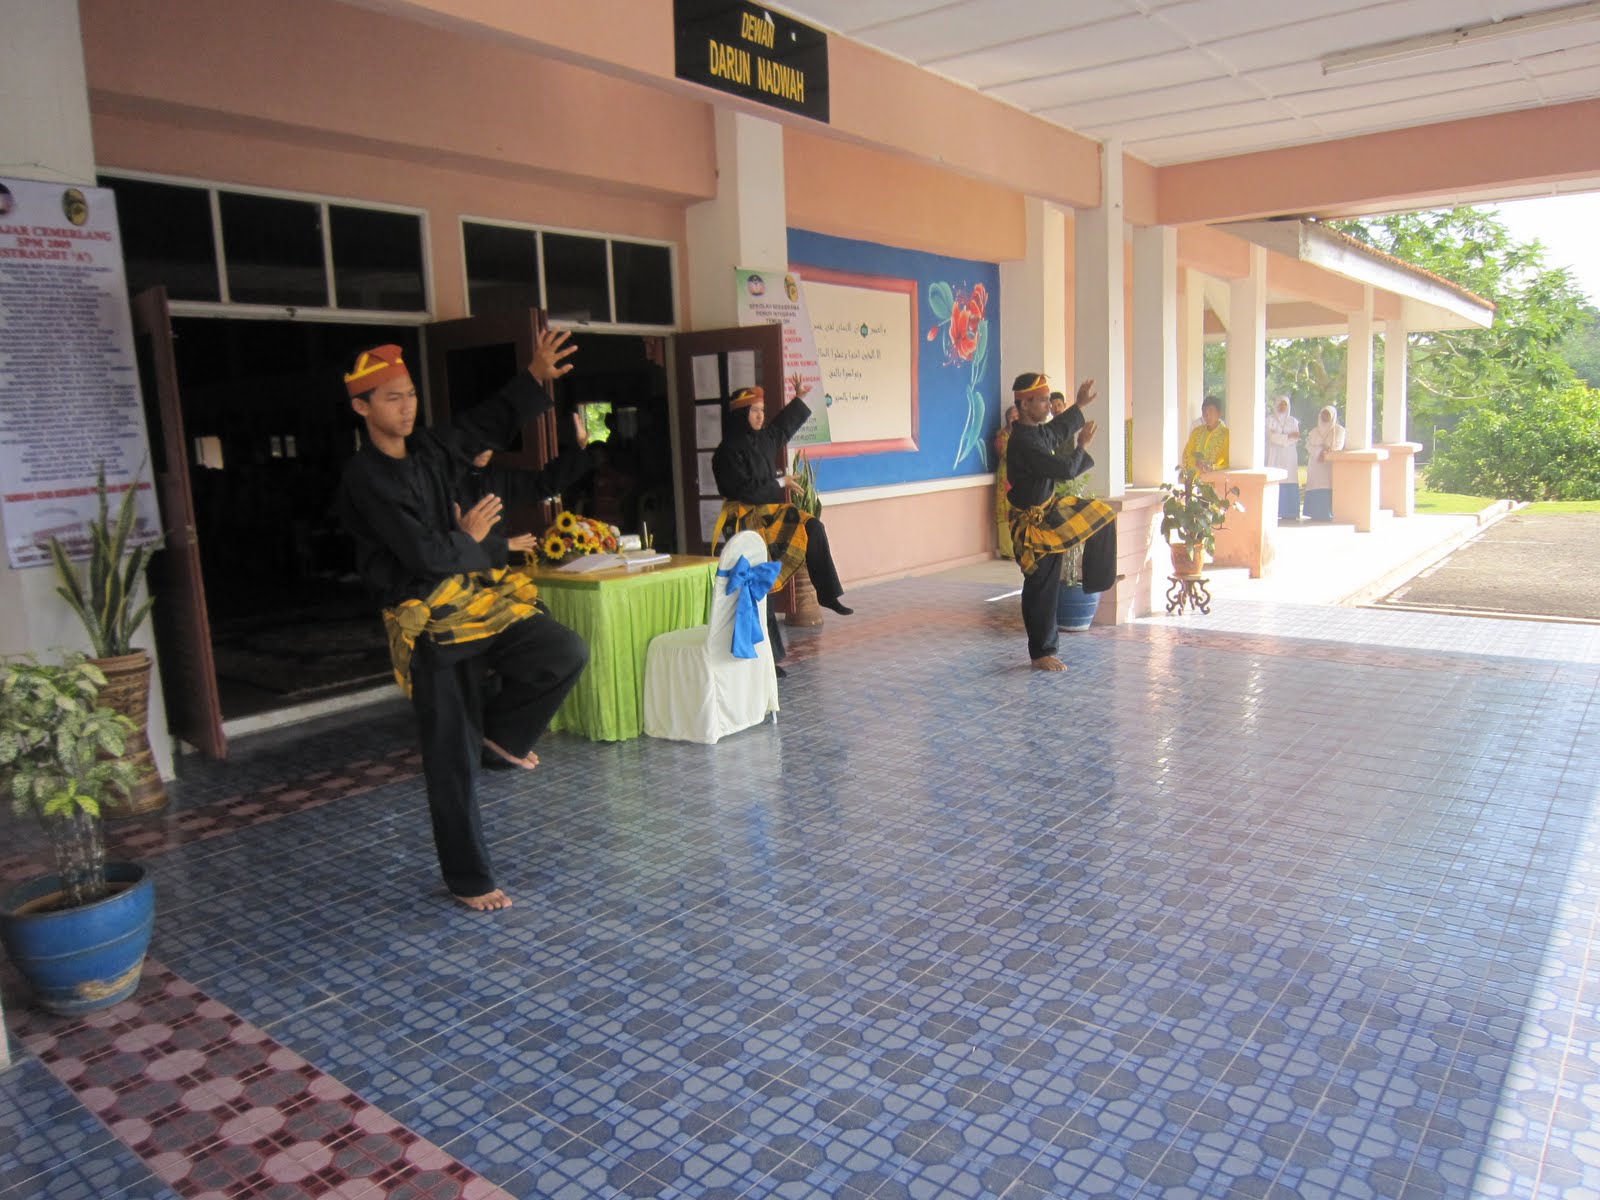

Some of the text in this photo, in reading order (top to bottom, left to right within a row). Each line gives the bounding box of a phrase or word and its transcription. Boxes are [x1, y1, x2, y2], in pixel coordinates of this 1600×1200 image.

[741, 12, 775, 48] DEWAN
[709, 39, 805, 103] DARUN NADWAH
